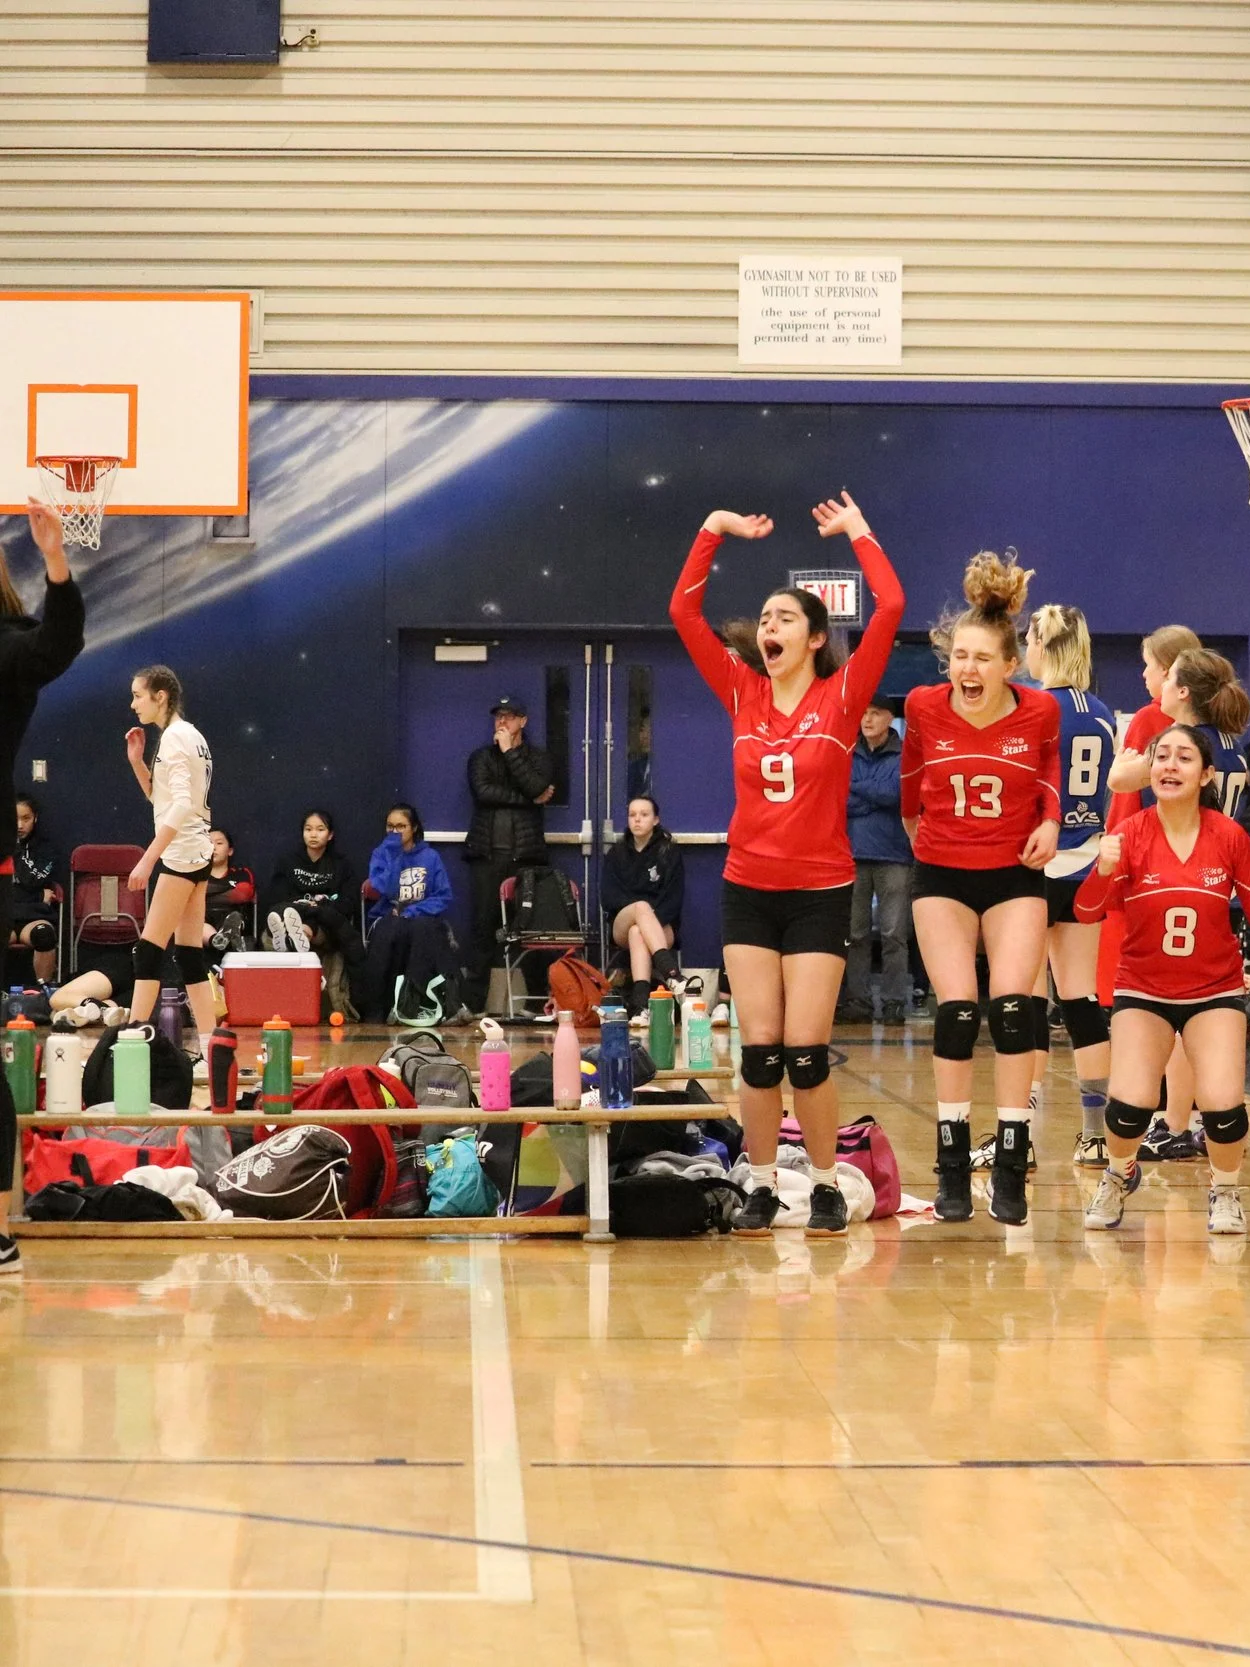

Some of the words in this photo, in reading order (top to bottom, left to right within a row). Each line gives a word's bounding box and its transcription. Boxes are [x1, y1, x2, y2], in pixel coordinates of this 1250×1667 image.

[744, 269, 803, 282] GYMNASIUM
[808, 270, 830, 282] NOT
[835, 270, 850, 282] TO
[854, 270, 867, 282] BE
[872, 271, 897, 283] USED
[762, 286, 810, 298] WITHOUT
[814, 286, 879, 298] SUPERVISION
[761, 308, 783, 318] (the
[789, 310, 808, 318] use
[815, 308, 828, 318] of
[833, 308, 881, 320] personal
[771, 321, 830, 333] equipment
[837, 321, 846, 331] is
[852, 322, 871, 331] not
[754, 333, 809, 345] permitted
[815, 335, 825, 343] at
[832, 335, 851, 345] any
[857, 334, 887, 345] time)
[1002, 744, 1029, 756] Stars
[1068, 735, 1102, 796] 8
[760, 752, 795, 803] 9
[949, 774, 1004, 818] 13
[1064, 811, 1100, 824] CVS
[1204, 874, 1227, 887] Stars
[1162, 907, 1197, 956] 8
